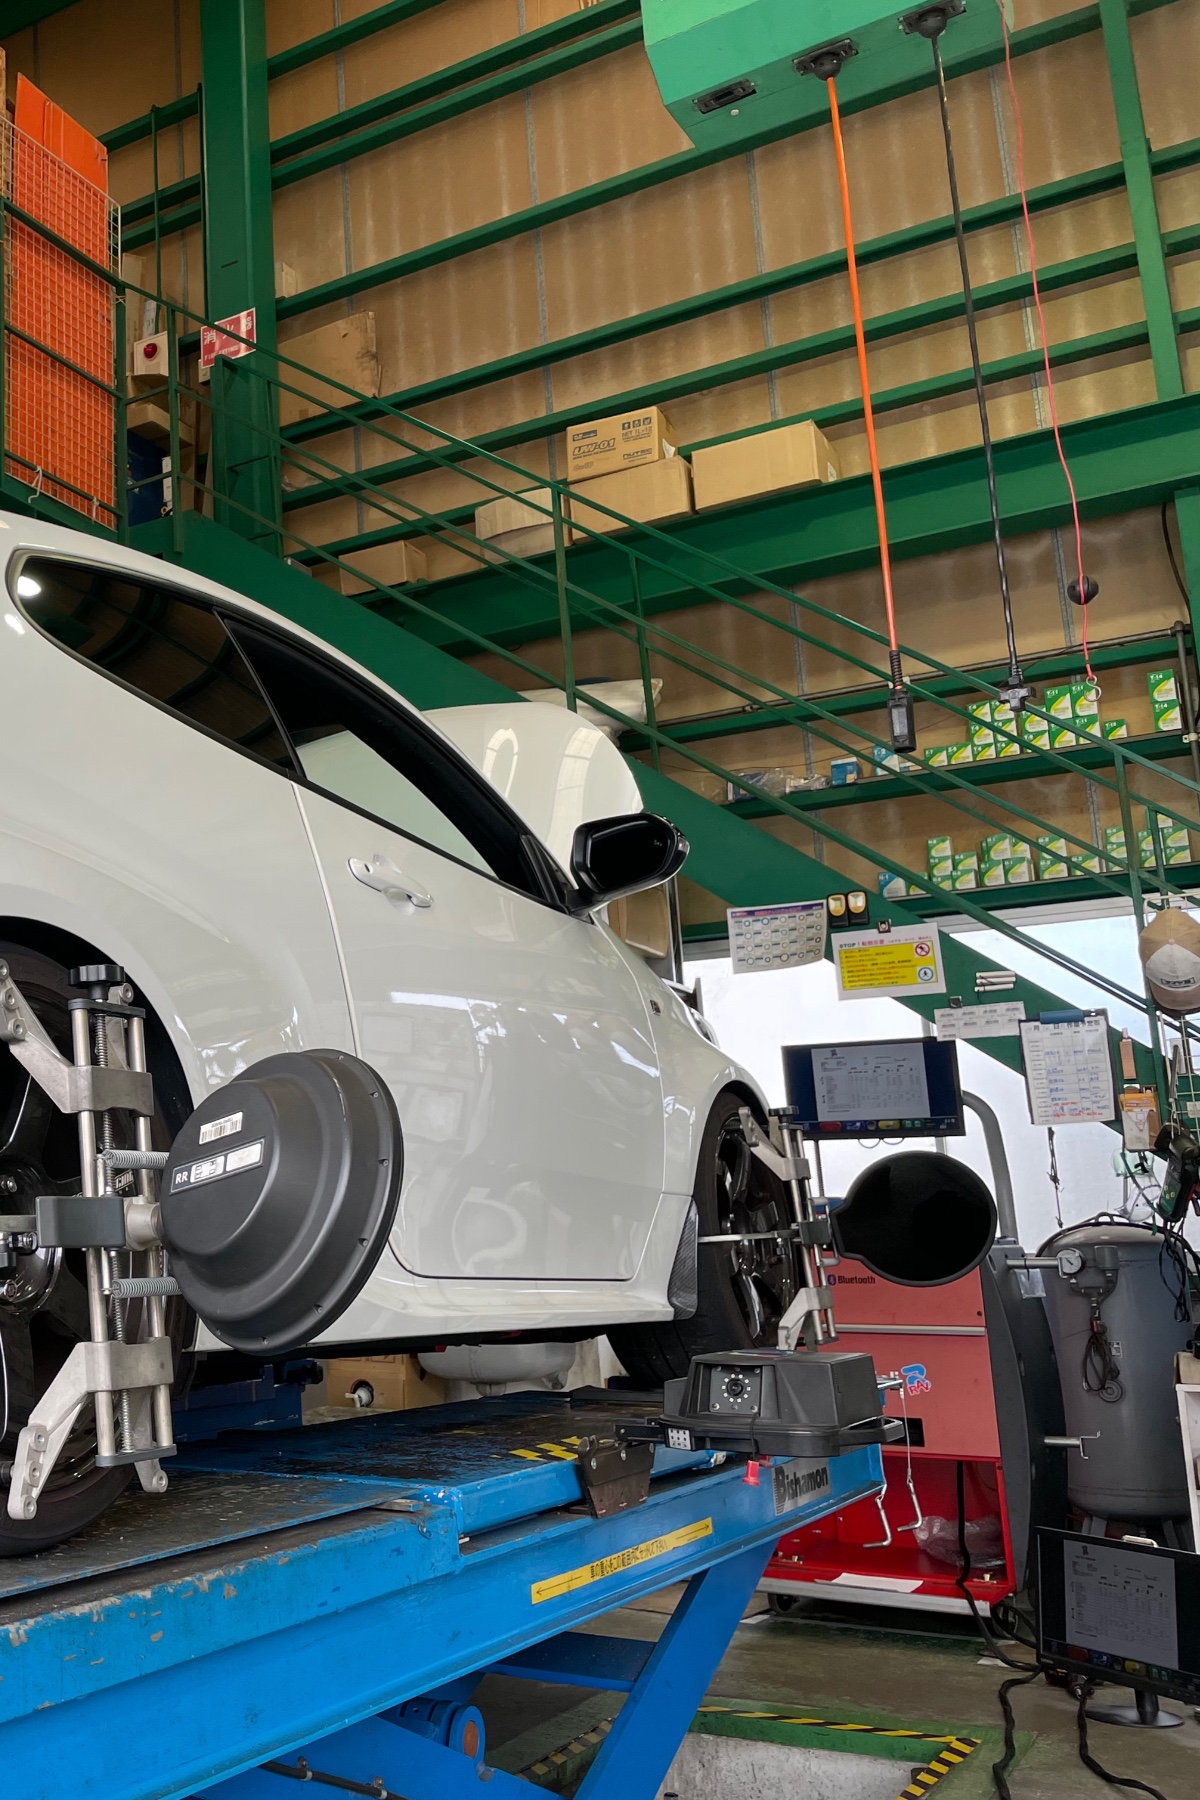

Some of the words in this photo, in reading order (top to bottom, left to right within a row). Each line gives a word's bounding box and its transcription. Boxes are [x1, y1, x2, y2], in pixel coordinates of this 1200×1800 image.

[175, 1171, 189, 1185] RR
[837, 1275, 876, 1285] Bluetooth
[908, 1379, 931, 1396] RAV
[773, 1465, 829, 1515] Bishamon
